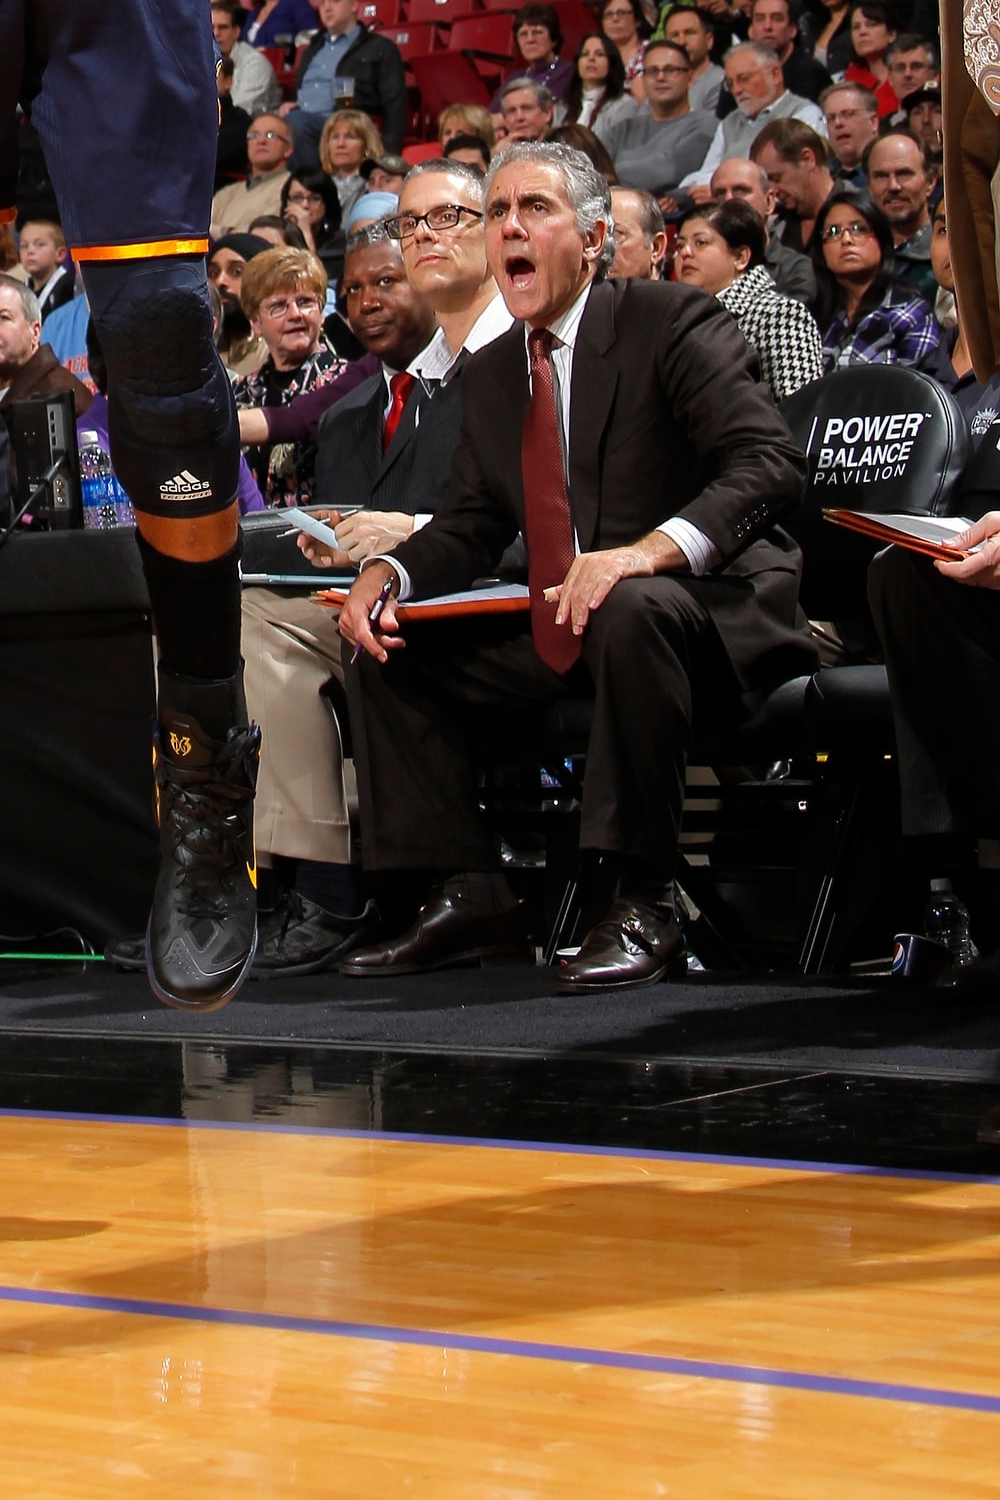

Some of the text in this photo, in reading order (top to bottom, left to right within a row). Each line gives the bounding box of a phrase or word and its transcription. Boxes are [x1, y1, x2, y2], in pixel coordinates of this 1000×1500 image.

[822, 412, 924, 445] POWER
[817, 441, 915, 469] BALANCE
[813, 463, 907, 486] PAVILION
[160, 481, 210, 493] adidas
[161, 490, 211, 500] TECHFIT
